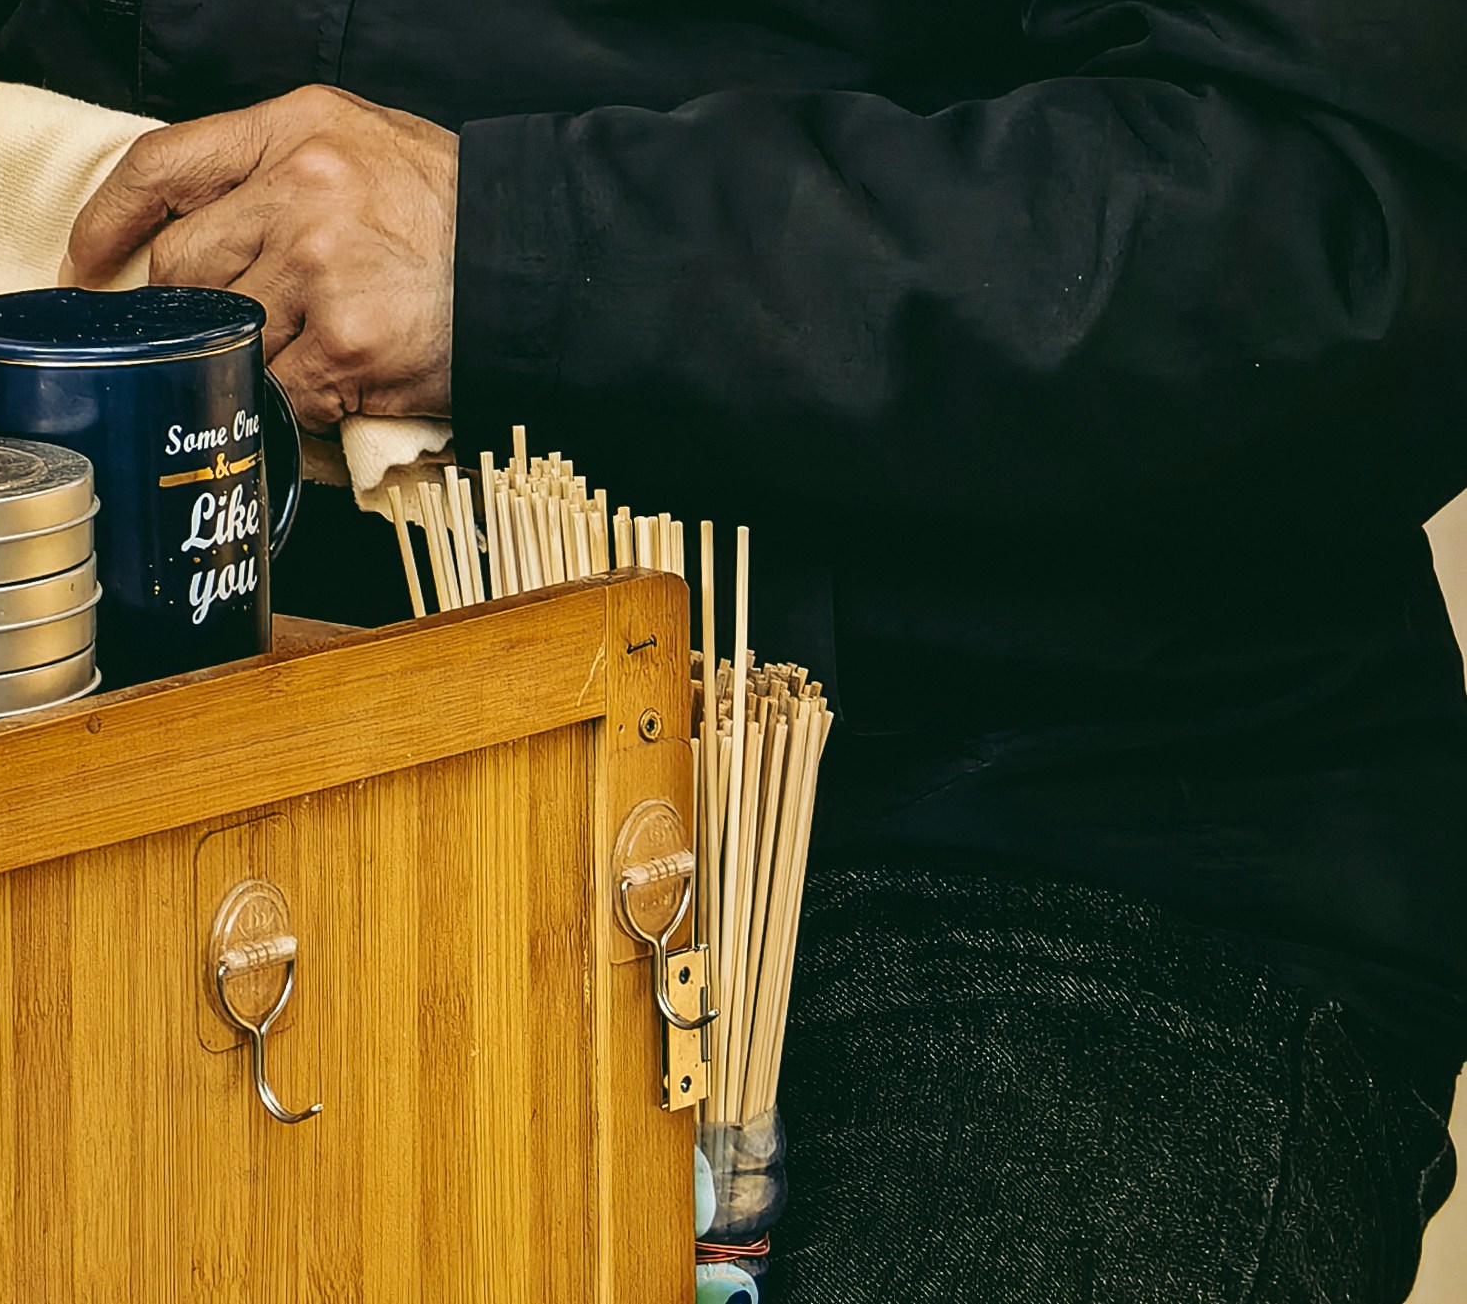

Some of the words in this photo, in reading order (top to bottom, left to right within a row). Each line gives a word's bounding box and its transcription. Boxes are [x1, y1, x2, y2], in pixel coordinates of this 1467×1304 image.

[165, 424, 228, 455] Some
[233, 409, 260, 441] One
[215, 452, 231, 480] &
[181, 483, 259, 553] Like
[189, 556, 257, 625] you
